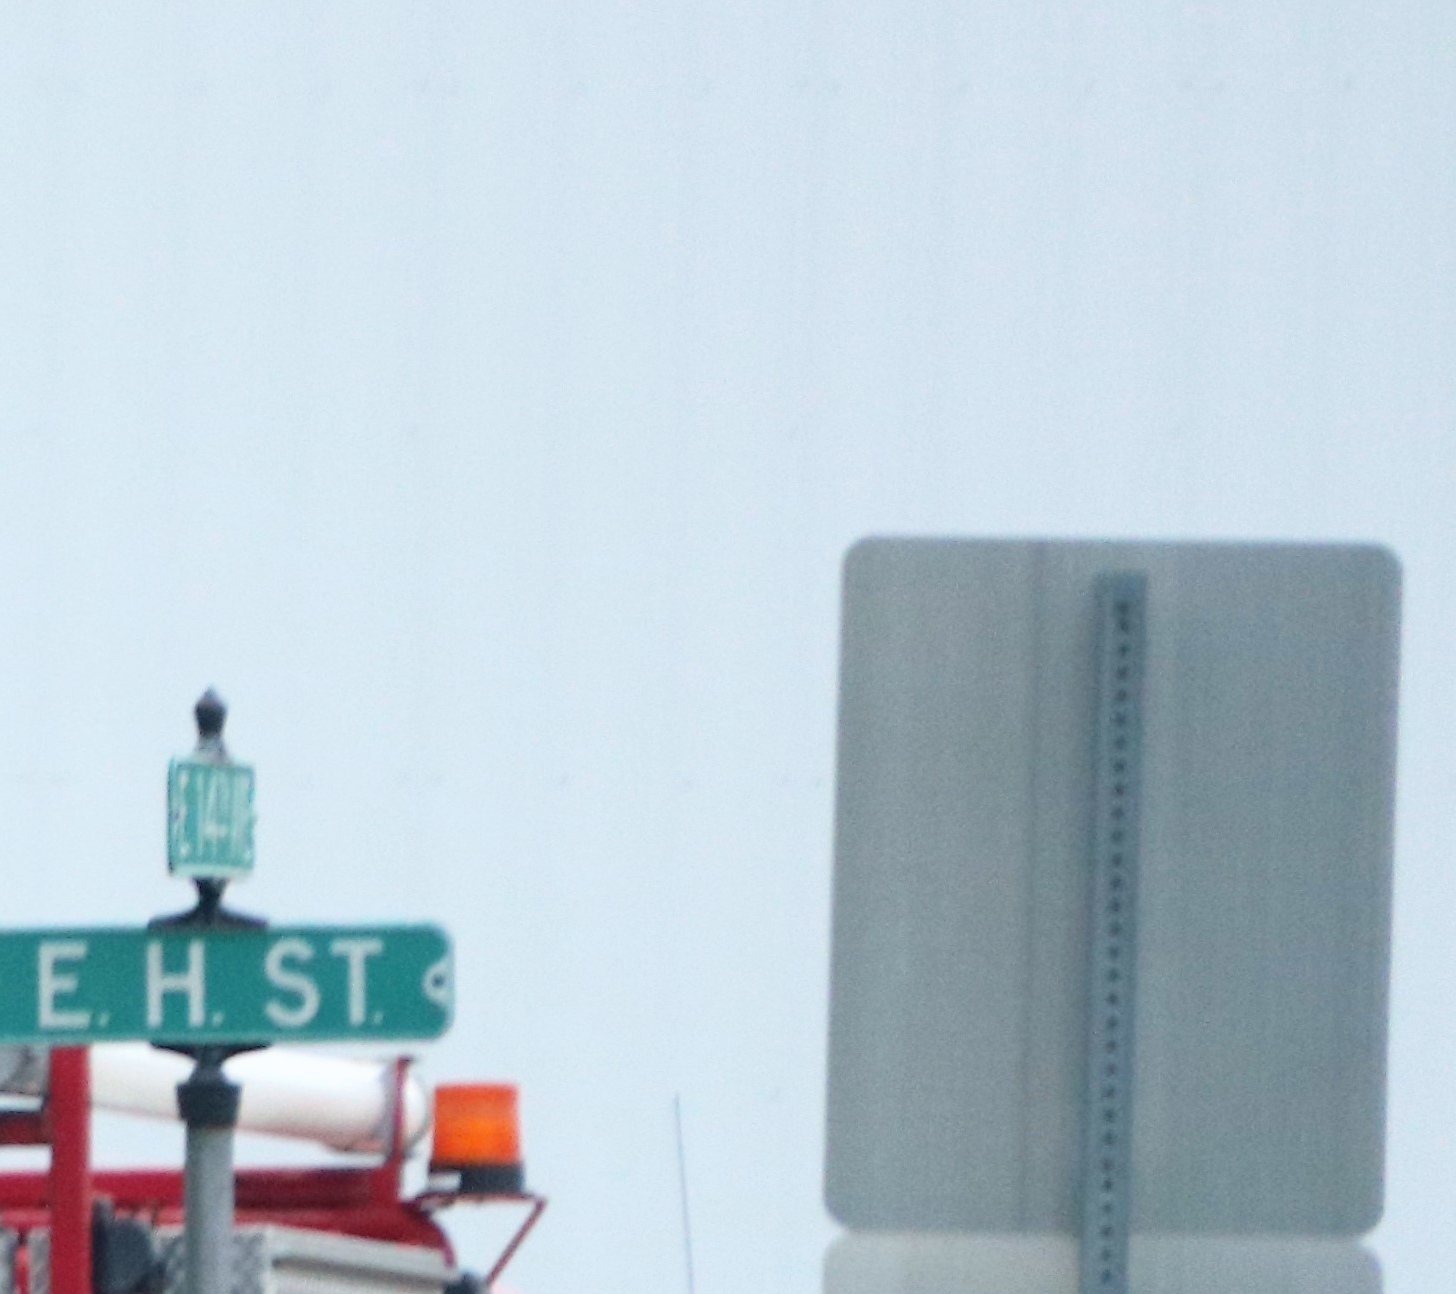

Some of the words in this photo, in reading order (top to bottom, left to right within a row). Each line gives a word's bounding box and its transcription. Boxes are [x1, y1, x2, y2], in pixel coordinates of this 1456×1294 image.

[36, 939, 109, 1030] E.
[145, 938, 225, 1030] H.
[264, 937, 385, 1030] ST.
